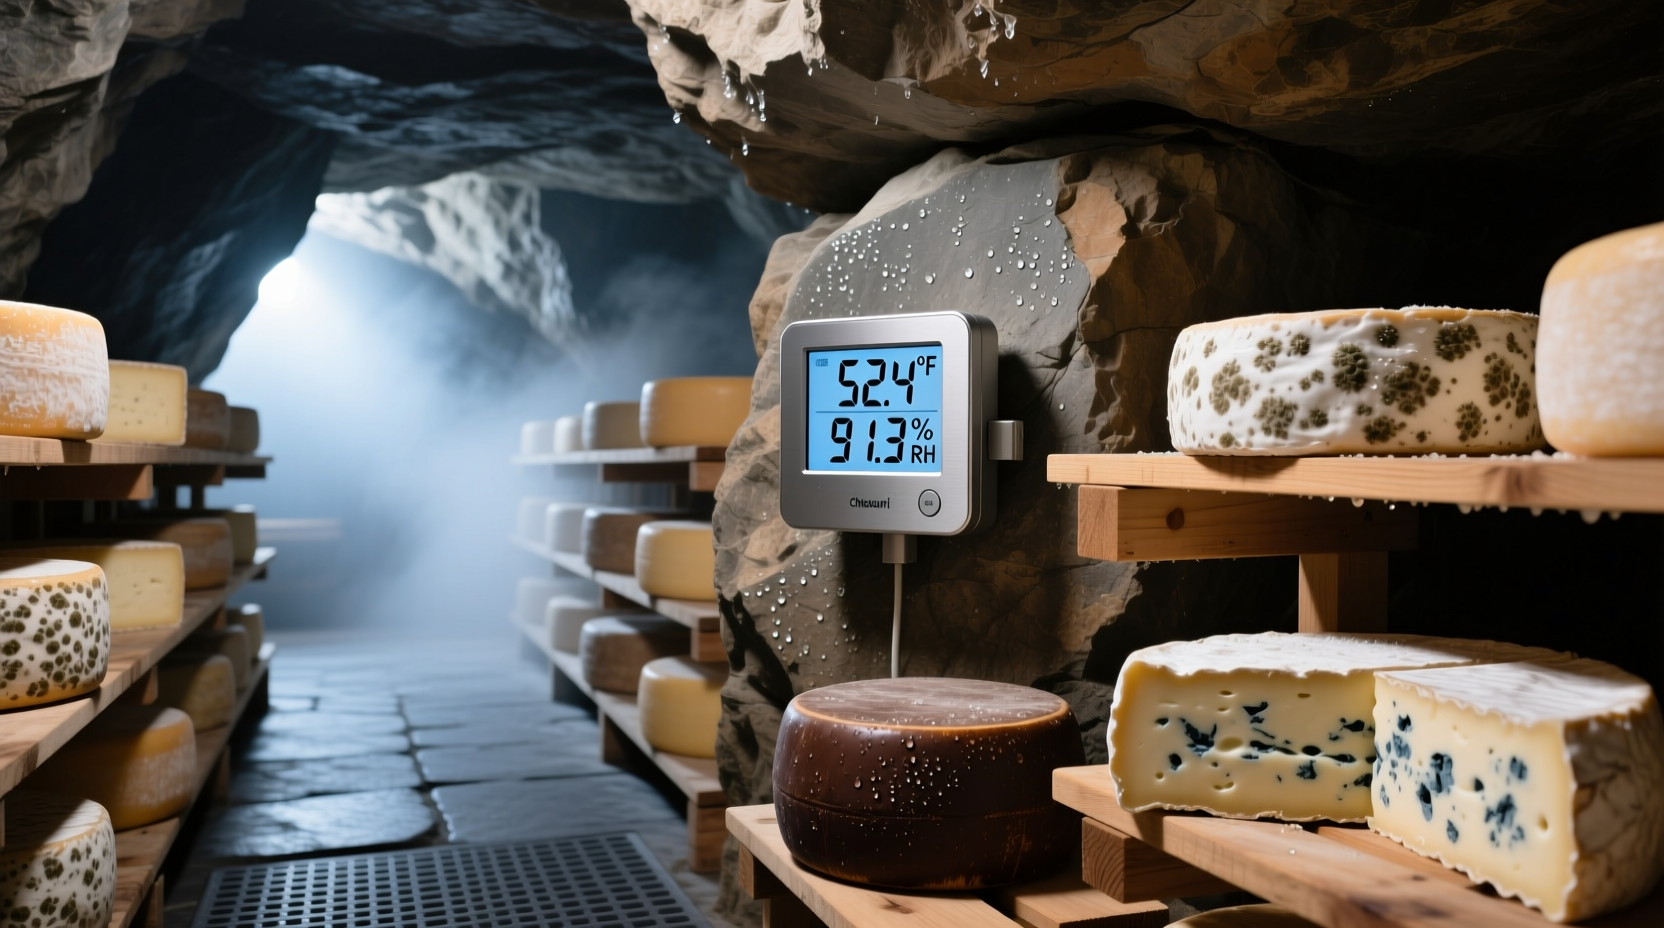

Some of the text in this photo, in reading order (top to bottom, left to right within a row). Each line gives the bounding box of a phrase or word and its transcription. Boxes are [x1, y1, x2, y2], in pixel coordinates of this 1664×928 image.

[838, 359, 915, 407] 52.4
[830, 417, 933, 463] 91.3 %
[911, 444, 935, 463] RH
